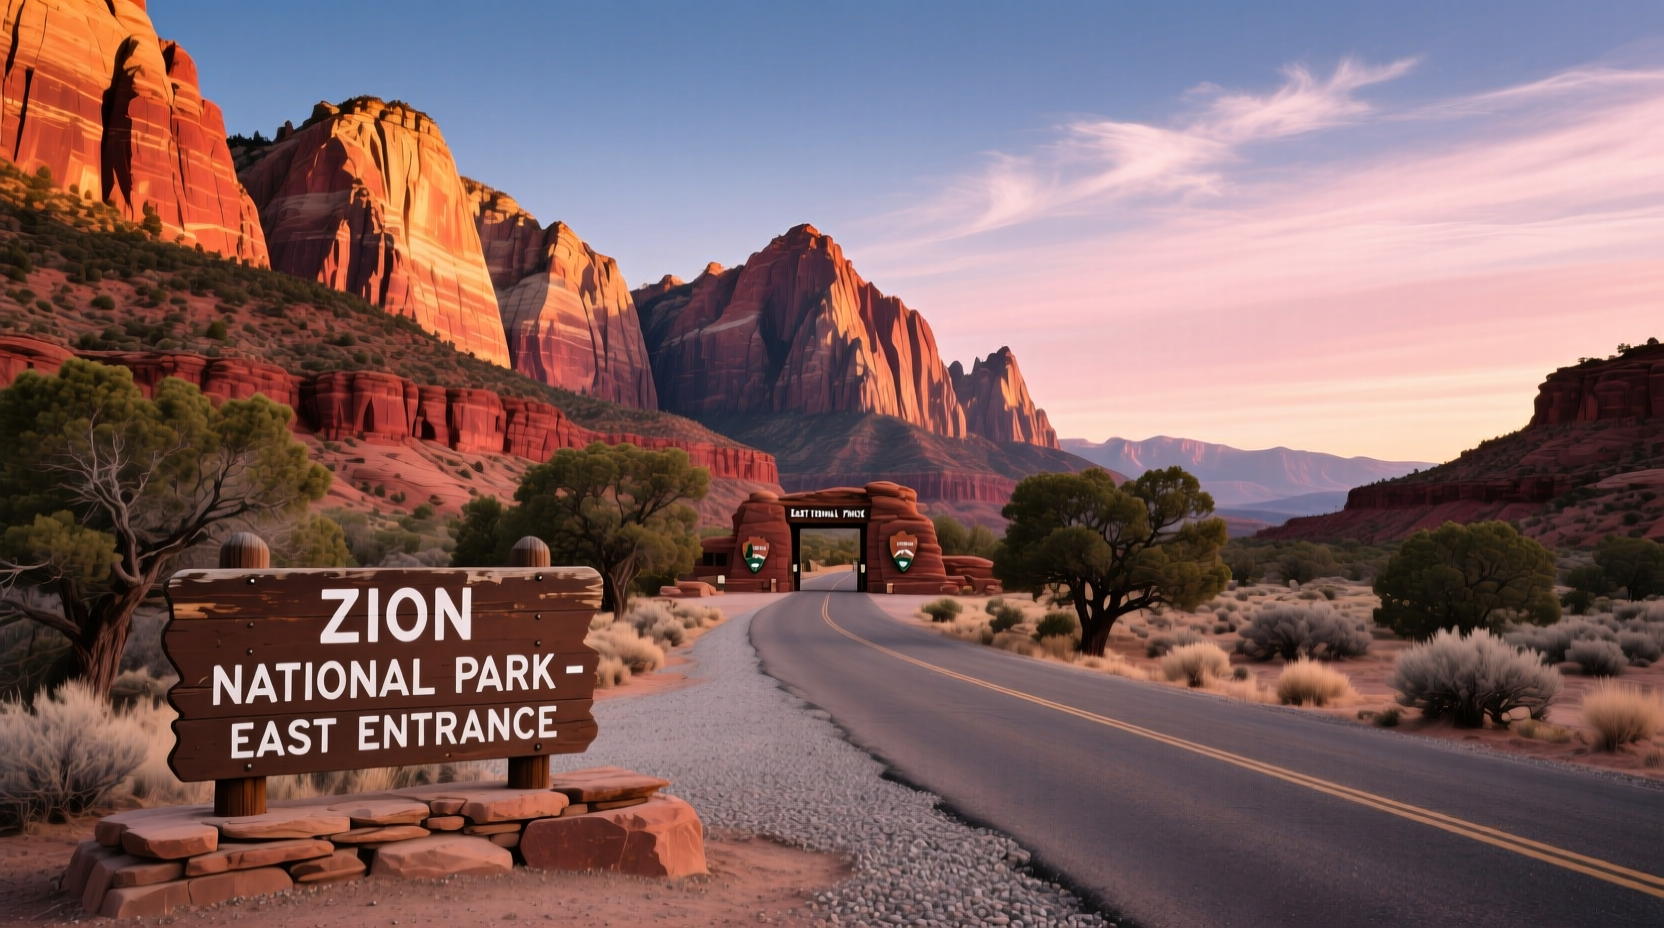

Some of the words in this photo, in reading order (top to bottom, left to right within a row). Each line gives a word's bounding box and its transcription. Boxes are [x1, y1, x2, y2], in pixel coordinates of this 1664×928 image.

[320, 587, 472, 644] ZION
[212, 658, 436, 706] NATIONAL
[455, 653, 556, 694] PARK
[231, 717, 337, 759] EAST
[358, 705, 558, 751] ENTRANCE
